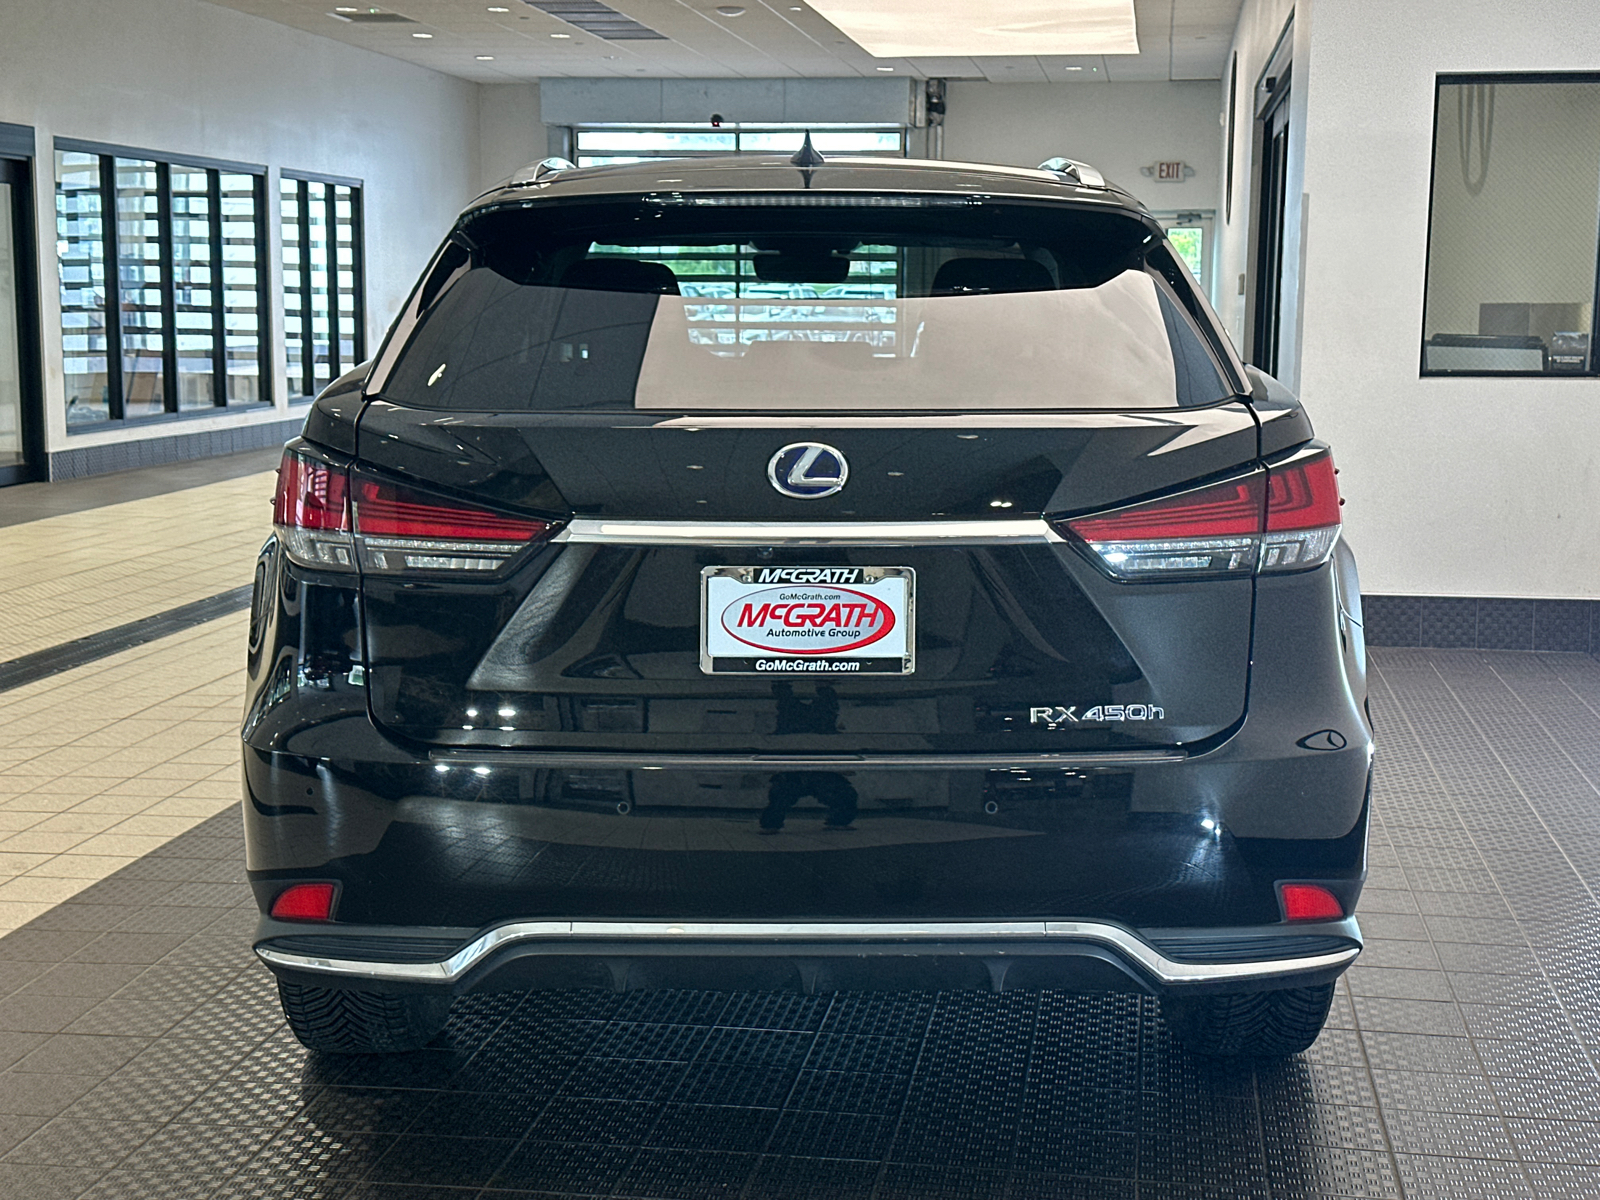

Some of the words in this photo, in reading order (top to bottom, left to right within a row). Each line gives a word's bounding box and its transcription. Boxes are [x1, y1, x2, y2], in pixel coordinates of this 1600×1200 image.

[1158, 162, 1181, 179] EXIT
[779, 592, 841, 601] GoMcGrath.com
[766, 628, 826, 638] Automotive
[828, 628, 861, 640] Group
[755, 659, 860, 672] GoMcGrath.com
